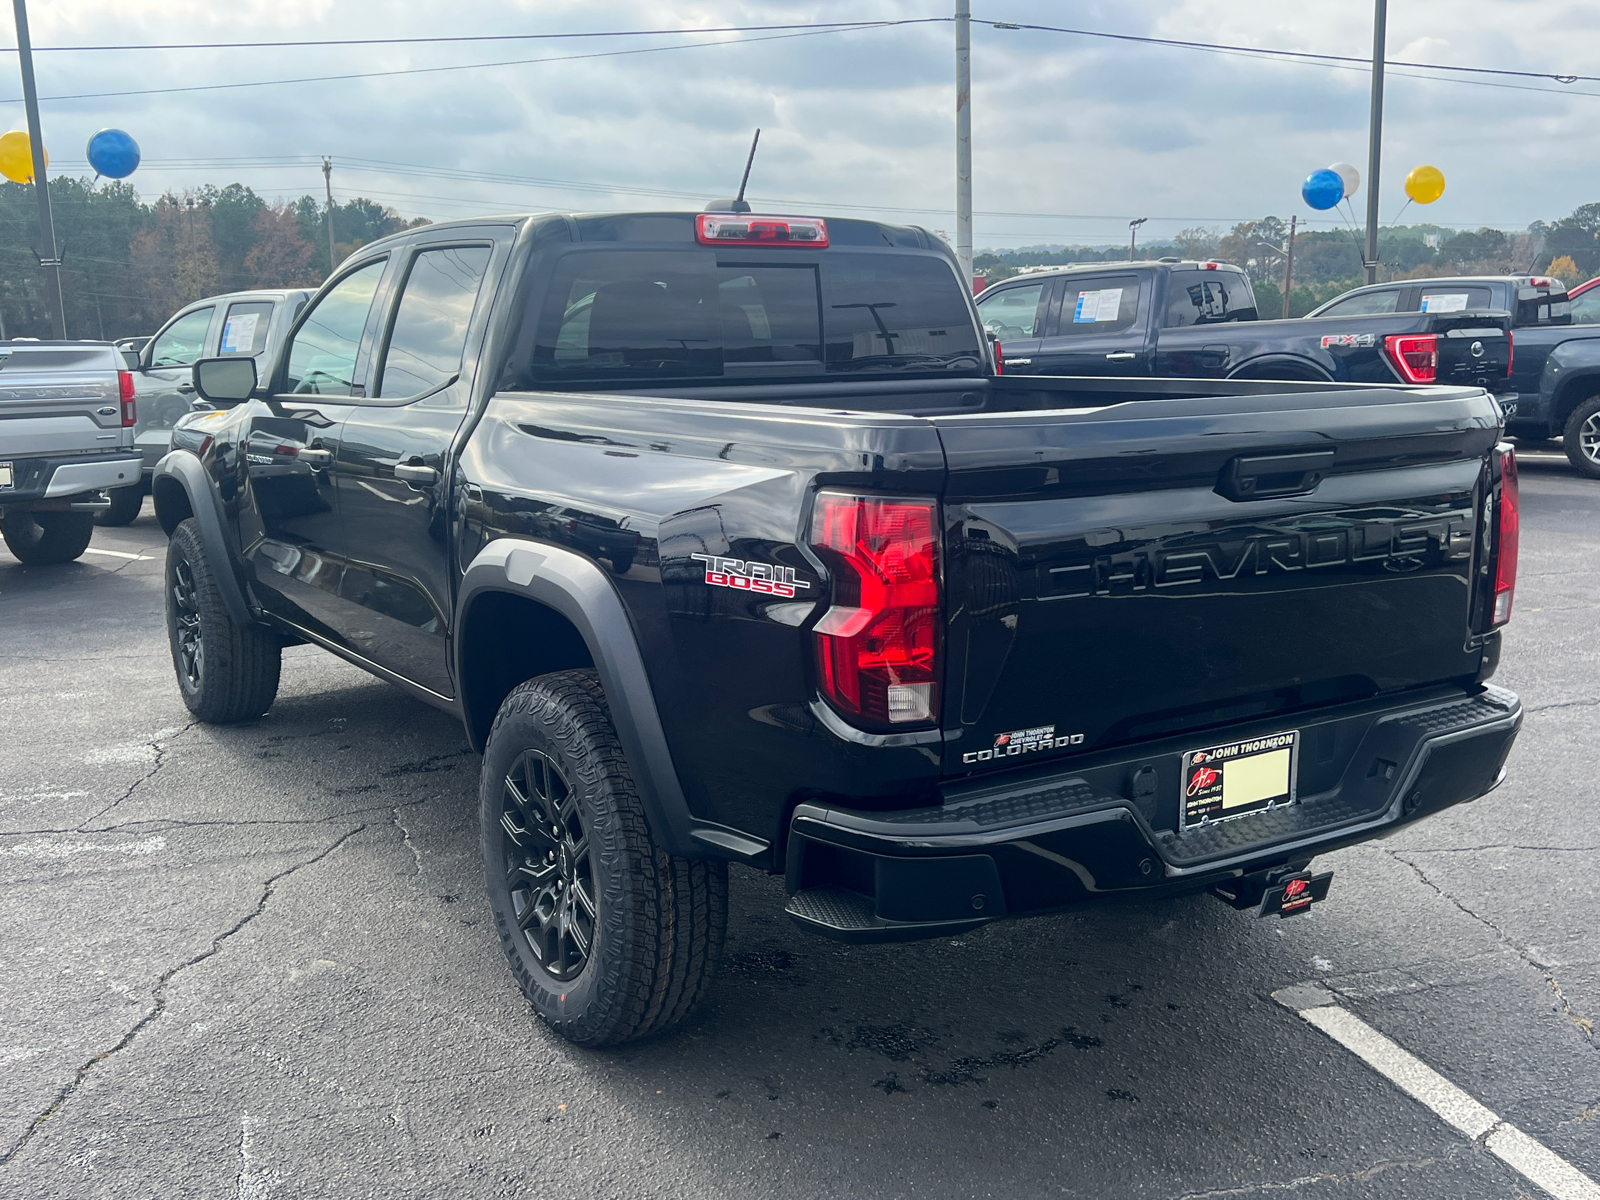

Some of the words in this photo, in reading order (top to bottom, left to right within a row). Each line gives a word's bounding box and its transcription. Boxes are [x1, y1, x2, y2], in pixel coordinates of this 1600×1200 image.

[1319, 333, 1375, 350] FX4
[691, 552, 811, 589] TRAIL
[1036, 514, 1464, 601] CHEVROLET
[705, 571, 796, 599] BOSS
[963, 733, 1085, 764] COLORADO
[1010, 735, 1044, 745] CHEVROLET
[1011, 731, 1026, 740] JOHN
[1211, 745, 1239, 760] JOHN
[1240, 734, 1295, 754] THORNTON
[495, 909, 560, 1013] WRANGLER
